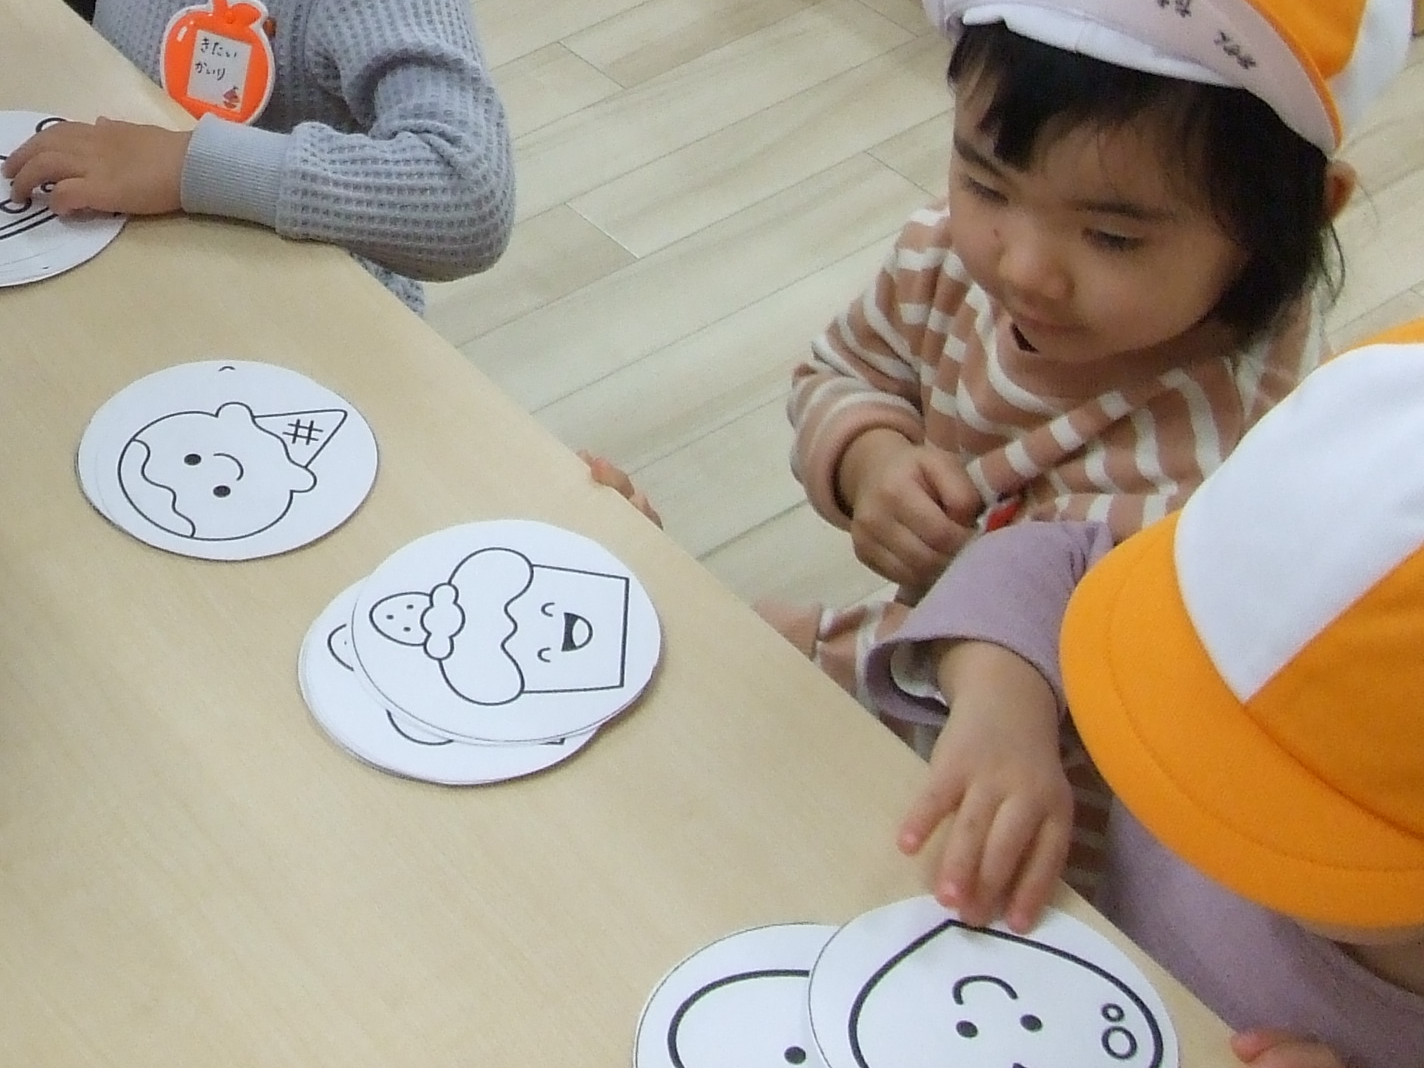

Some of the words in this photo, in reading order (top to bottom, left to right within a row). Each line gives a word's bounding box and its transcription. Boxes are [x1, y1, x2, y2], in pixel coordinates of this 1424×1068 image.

[200, 37, 238, 58] きたい
[194, 61, 226, 81] かいり
